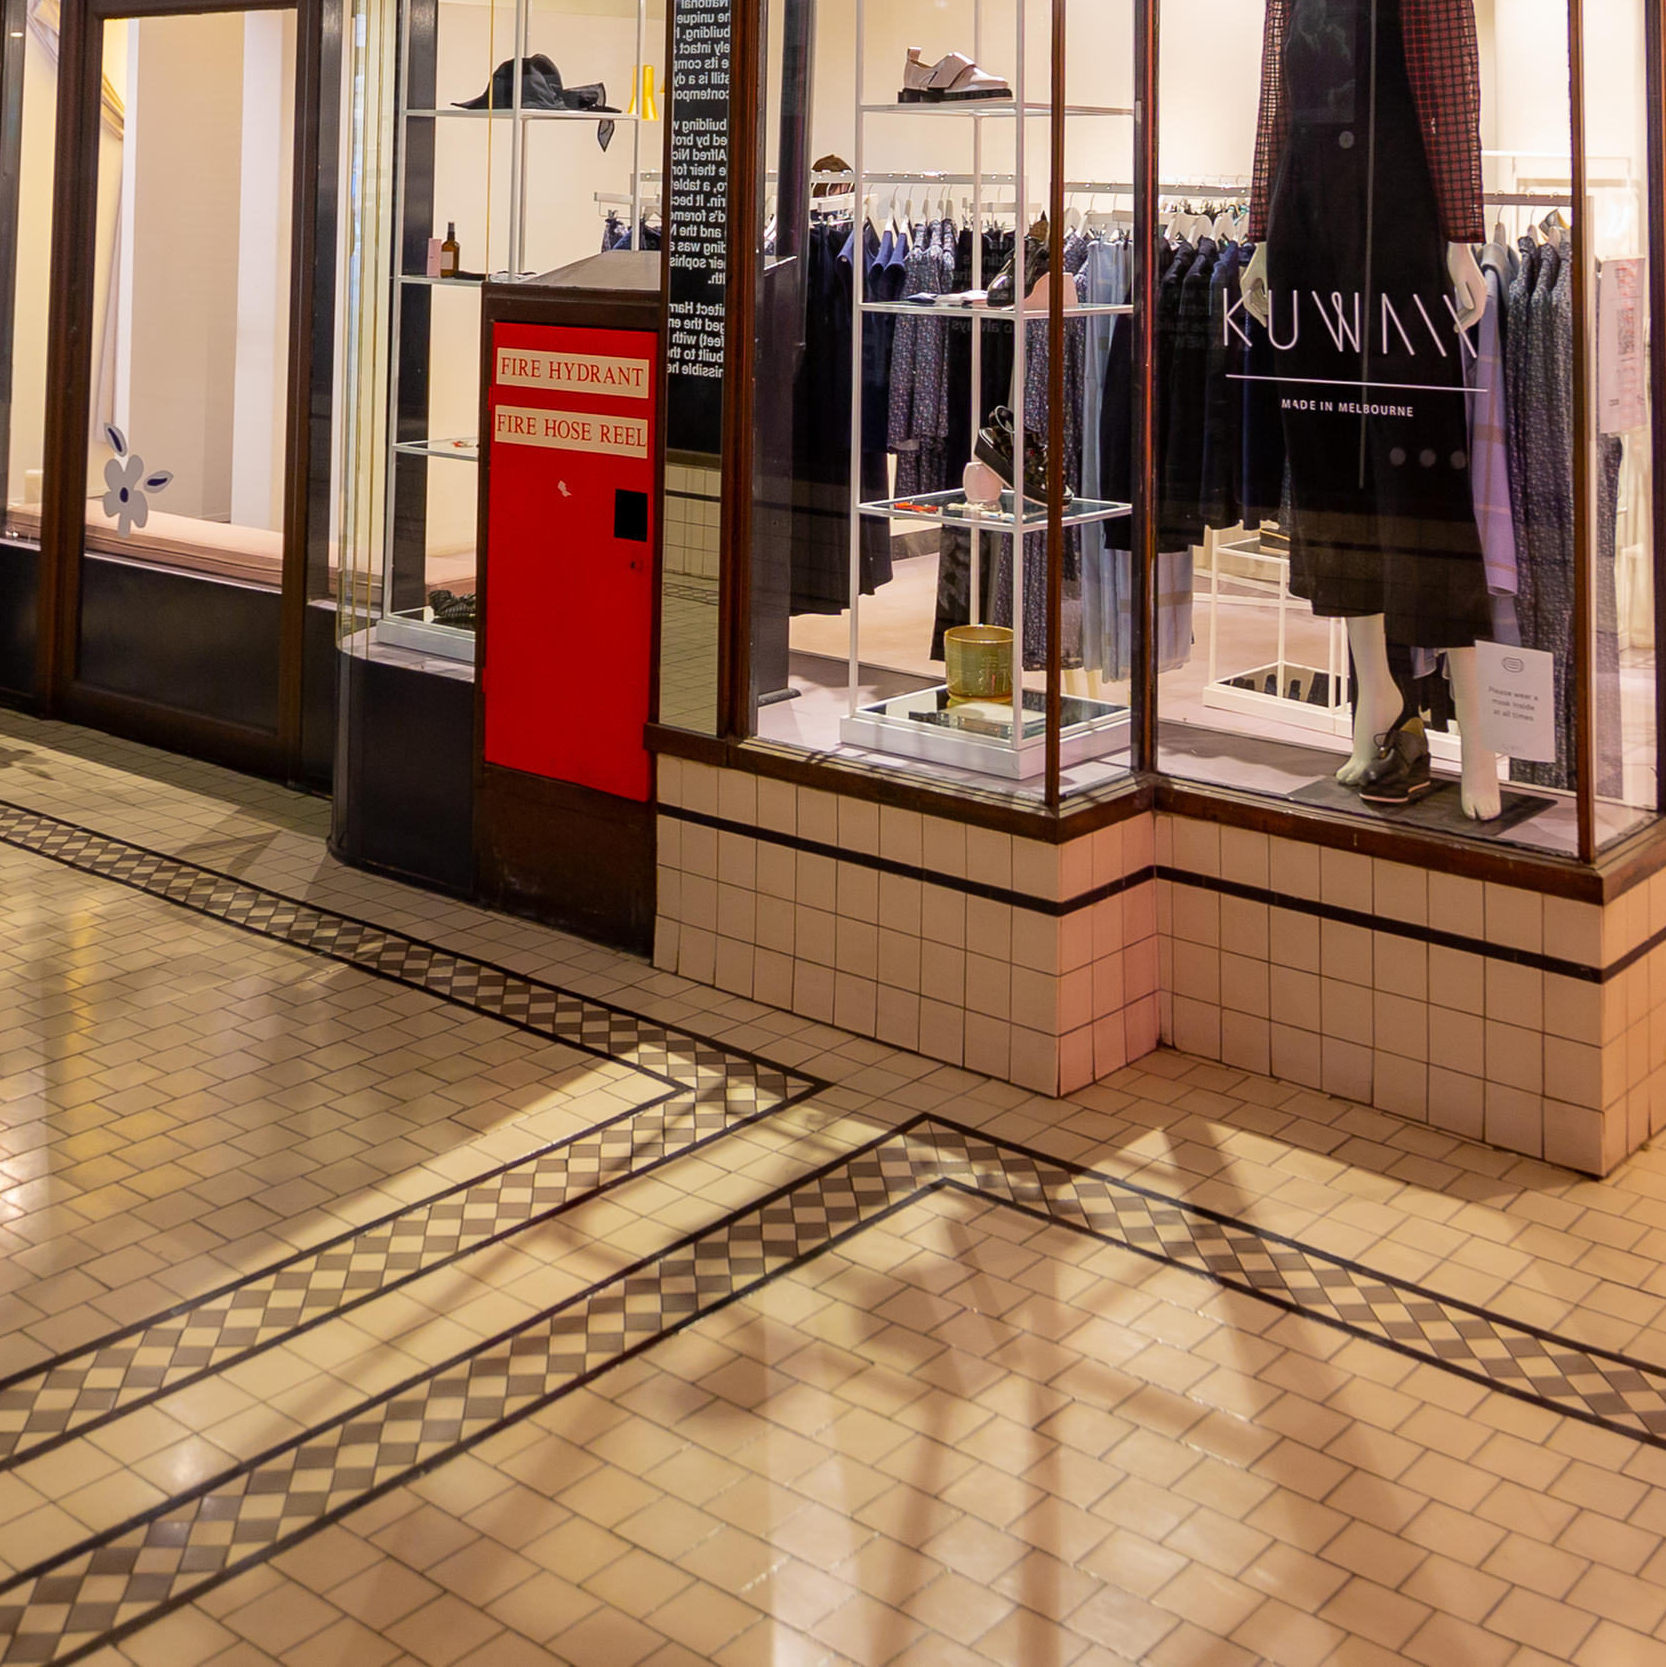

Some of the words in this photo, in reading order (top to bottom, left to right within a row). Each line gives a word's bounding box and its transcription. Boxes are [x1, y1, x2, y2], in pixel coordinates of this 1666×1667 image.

[501, 357, 542, 378] FIRE
[549, 361, 644, 387] HYDRANT
[1281, 399, 1316, 411] MADE
[1320, 401, 1333, 412] IN
[1338, 403, 1414, 417] MELBOURNE
[497, 414, 537, 435] FIRE
[544, 418, 592, 441] HOSE
[600, 424, 647, 447] REEL
